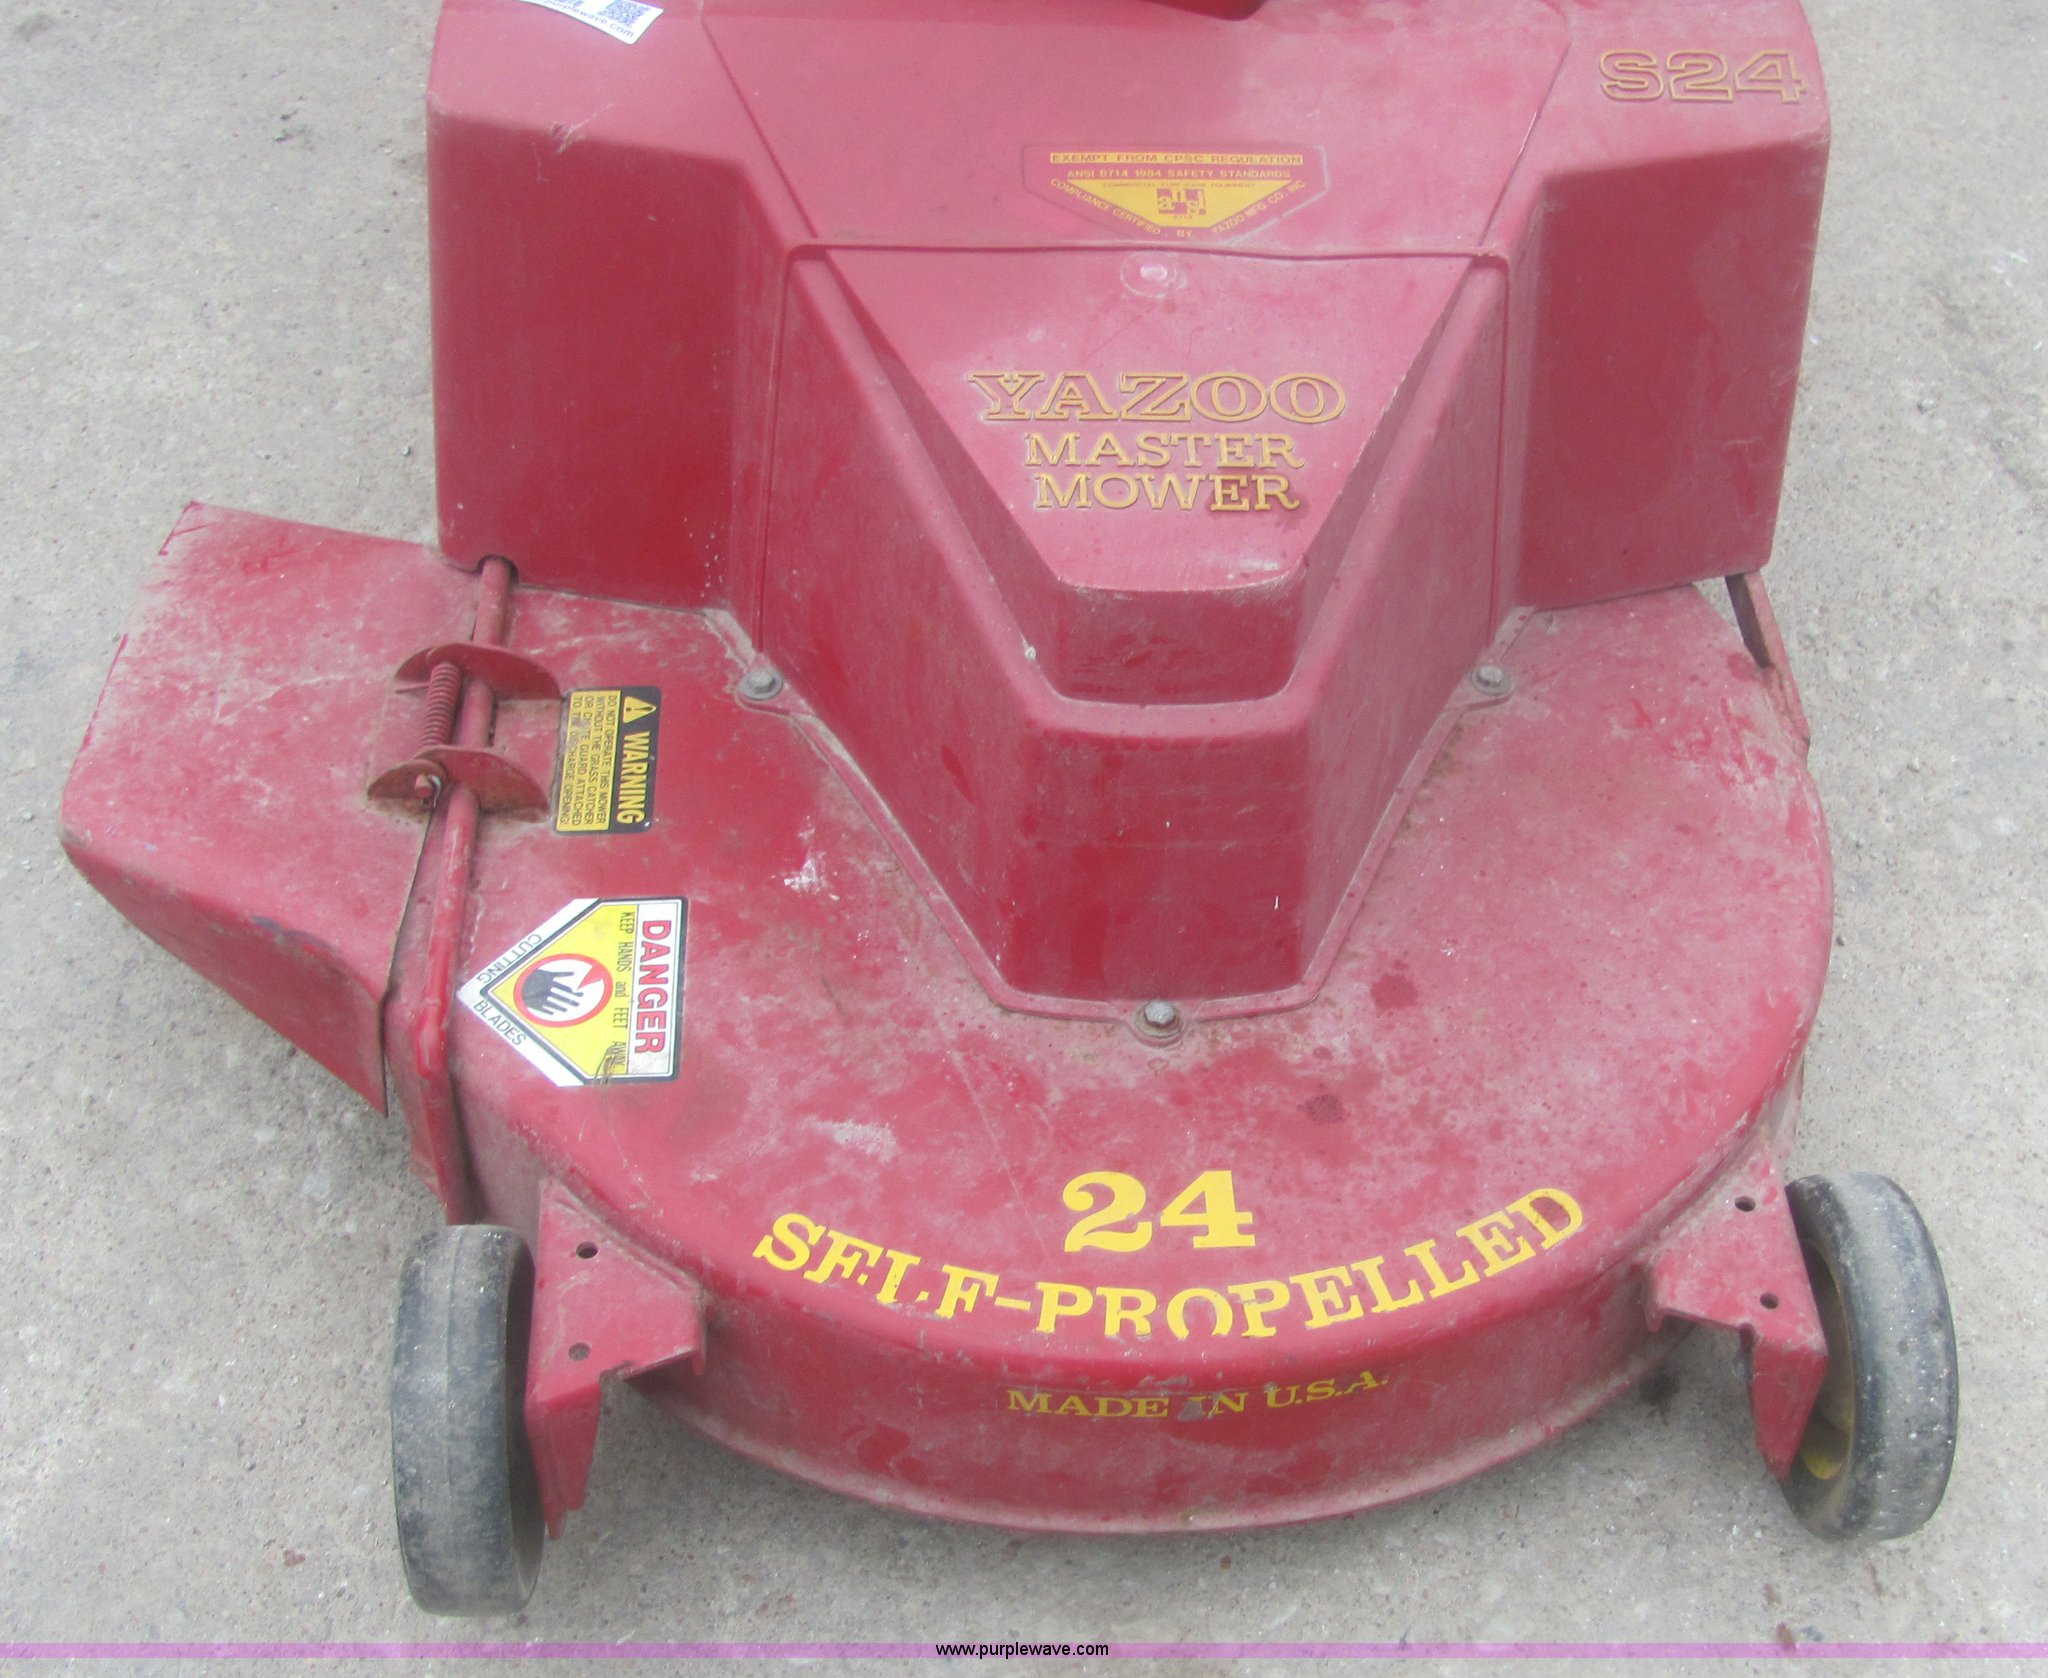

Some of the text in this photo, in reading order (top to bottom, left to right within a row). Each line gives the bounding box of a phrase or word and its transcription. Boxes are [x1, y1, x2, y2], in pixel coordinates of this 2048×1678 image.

[1600, 49, 1807, 104] S24
[1052, 154, 1301, 165] EXEMPT FROM CPSC REGULATION
[1067, 169, 1095, 178] ANSI
[1167, 169, 1214, 179] SAFETY
[1220, 169, 1291, 179] STANDARDS
[1051, 178, 1109, 212] COMPLIANCE
[1112, 208, 1161, 236] CERTIFIED
[1176, 229, 1193, 238] BY
[968, 370, 1346, 424] YAZOO
[1024, 431, 1306, 469] MASTER
[1034, 470, 1304, 512] MOWER
[573, 696, 583, 708] TO
[585, 696, 595, 708] OR
[577, 744, 589, 775] GUARD
[585, 696, 606, 824] WITHOUT THE GRASS CATCHER
[595, 695, 617, 824] DO NOT OPERATE THIS MOWER
[616, 730, 651, 824] WARNING
[572, 779, 586, 826] ATTACHED
[619, 911, 635, 934] KEEP
[477, 932, 543, 985] CUTTING
[616, 942, 633, 973] HANDS
[614, 981, 630, 998] and
[634, 919, 673, 1054] DANGER
[473, 999, 527, 1047] BLADES
[612, 1008, 630, 1030] FEET
[1062, 1170, 1256, 1253] 24
[753, 1187, 1584, 1340] SELF-PROPELLED
[1005, 1389, 1169, 1418] MADE
